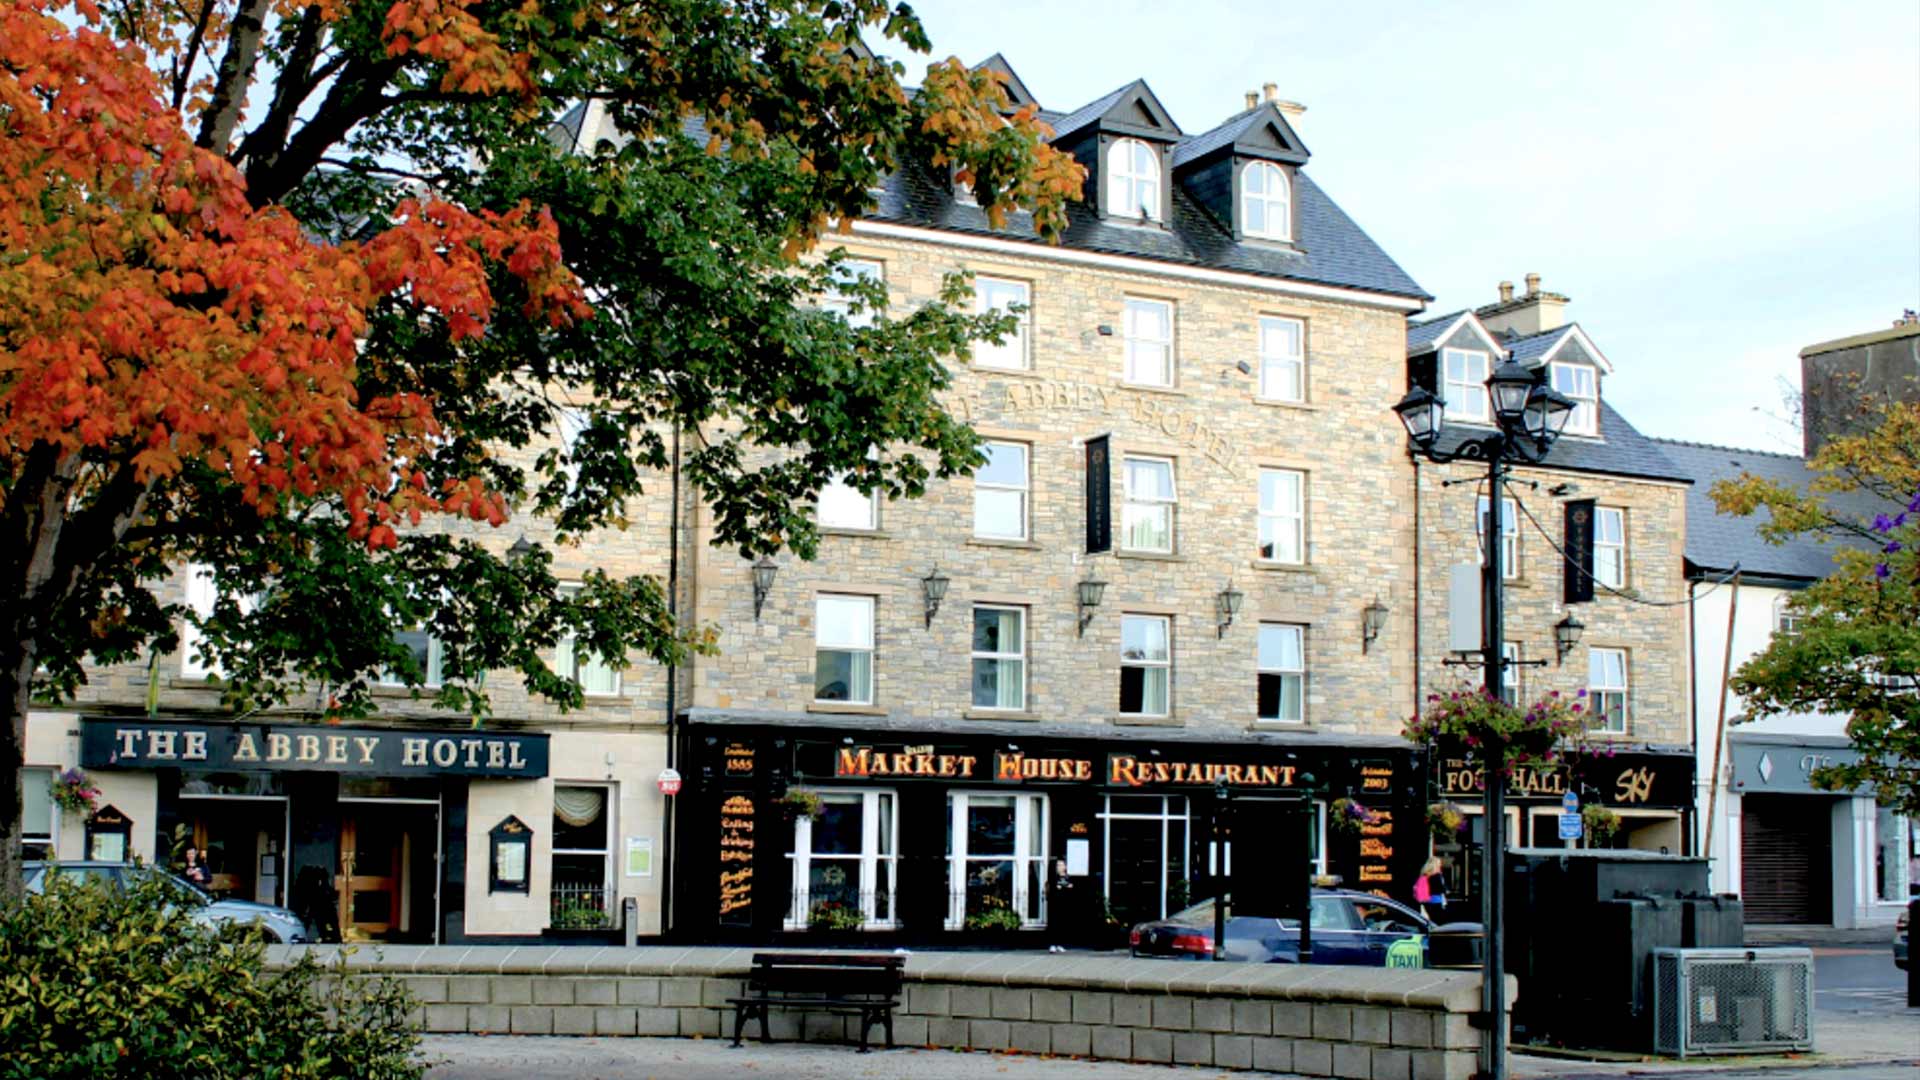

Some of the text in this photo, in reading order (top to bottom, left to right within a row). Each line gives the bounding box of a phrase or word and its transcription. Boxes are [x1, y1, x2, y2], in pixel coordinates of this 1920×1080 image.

[1004, 383, 1117, 415] ABBEY
[1128, 393, 1238, 478] HOTEL
[115, 729, 527, 769] THE ABBEY HOTEL
[838, 748, 1296, 786] MARKET HOUSE RESTAURANT
[1510, 768, 1565, 795] HALL
[1392, 955, 1418, 969] TAXI
